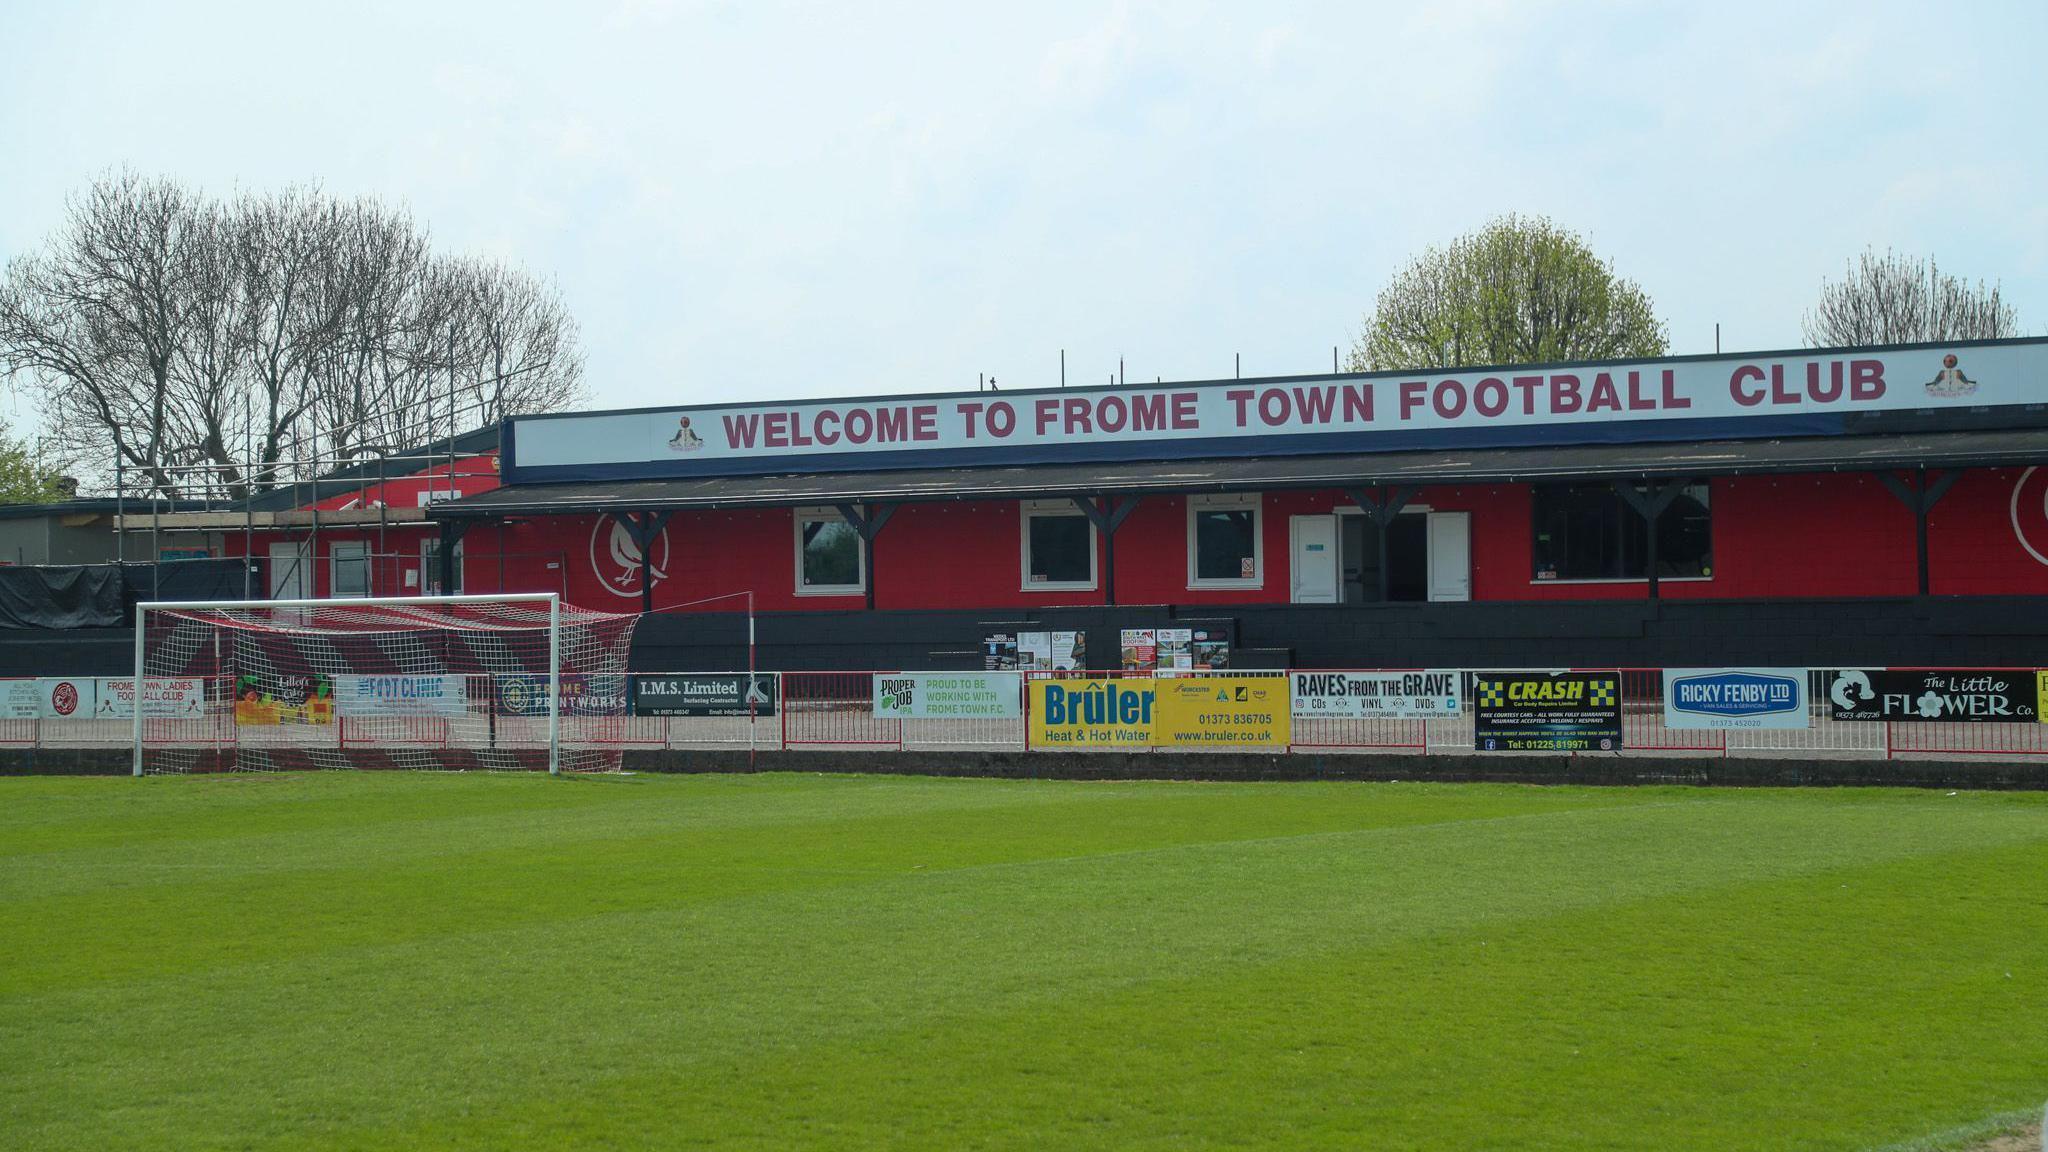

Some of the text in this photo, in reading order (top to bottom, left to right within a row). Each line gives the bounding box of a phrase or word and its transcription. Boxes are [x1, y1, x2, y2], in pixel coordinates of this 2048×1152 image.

[722, 359, 1887, 449] WELCOME TO FROME TOWN FOOTBALL CLUB
[107, 681, 135, 690] FROME
[163, 681, 193, 690] LADIES
[401, 678, 443, 697] CLINIC
[535, 683, 581, 694] FRME
[640, 681, 738, 695] I.M.S. Limited
[880, 679, 915, 696] PROPER
[926, 679, 985, 689] PROUD TO BE
[1298, 674, 1454, 696] RAVES FROM THE GRAVE
[1924, 676, 2009, 692] The Little
[162, 691, 183, 700] CLUB
[1508, 681, 1584, 700] CRASH
[1681, 684, 1790, 702] RICKY FENBY LTD
[535, 696, 627, 708] PRNTWORKS
[893, 691, 912, 710] JOB
[926, 692, 997, 701] WORKING WITH
[926, 704, 958, 714] FROME
[960, 704, 987, 714] TOWN
[1045, 682, 1155, 725] Brûler
[1361, 699, 1383, 708] VINYL
[1415, 699, 1435, 708] DVDs
[900, 706, 912, 714] IPA
[2016, 704, 2034, 715] Co.
[1199, 714, 1272, 724] 01373 836705
[1045, 729, 1150, 741] Heat & Hot Water
[1174, 730, 1272, 741] www.bruler.co.uk
[1507, 740, 1588, 749] Tel: 01225 819971
